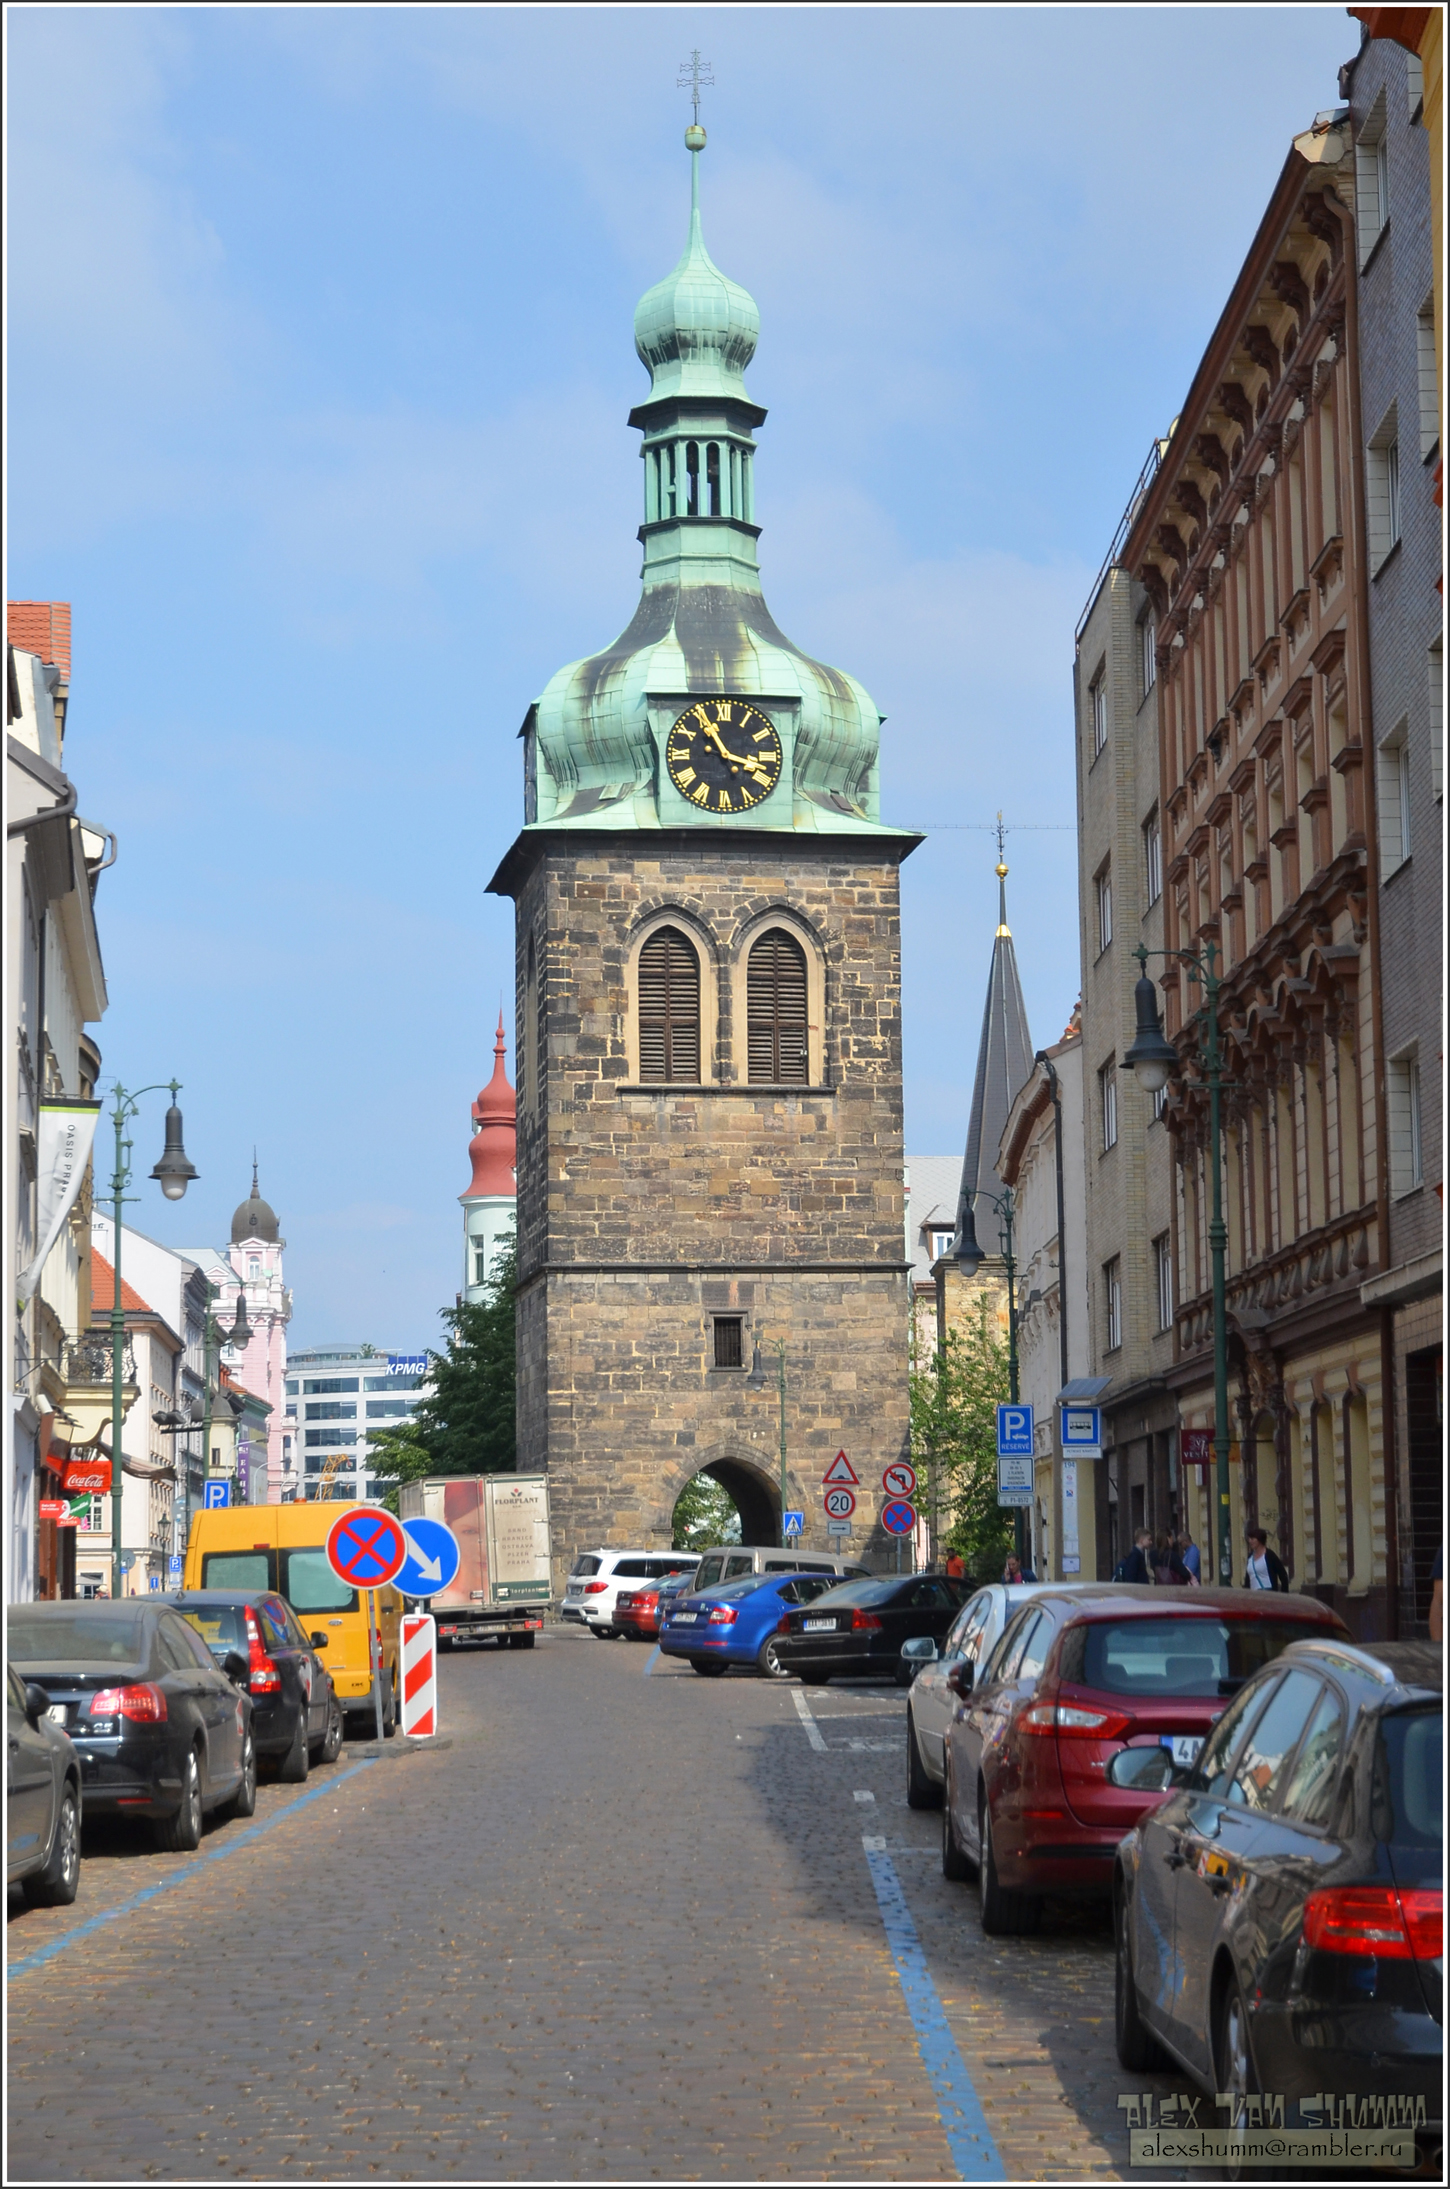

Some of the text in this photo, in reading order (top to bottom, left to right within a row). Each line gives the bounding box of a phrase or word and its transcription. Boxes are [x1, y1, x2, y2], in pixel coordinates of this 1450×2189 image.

[65, 1124, 75, 1158] OASIS
[385, 1362, 426, 1375] KPMG
[830, 1495, 850, 1512] 20
